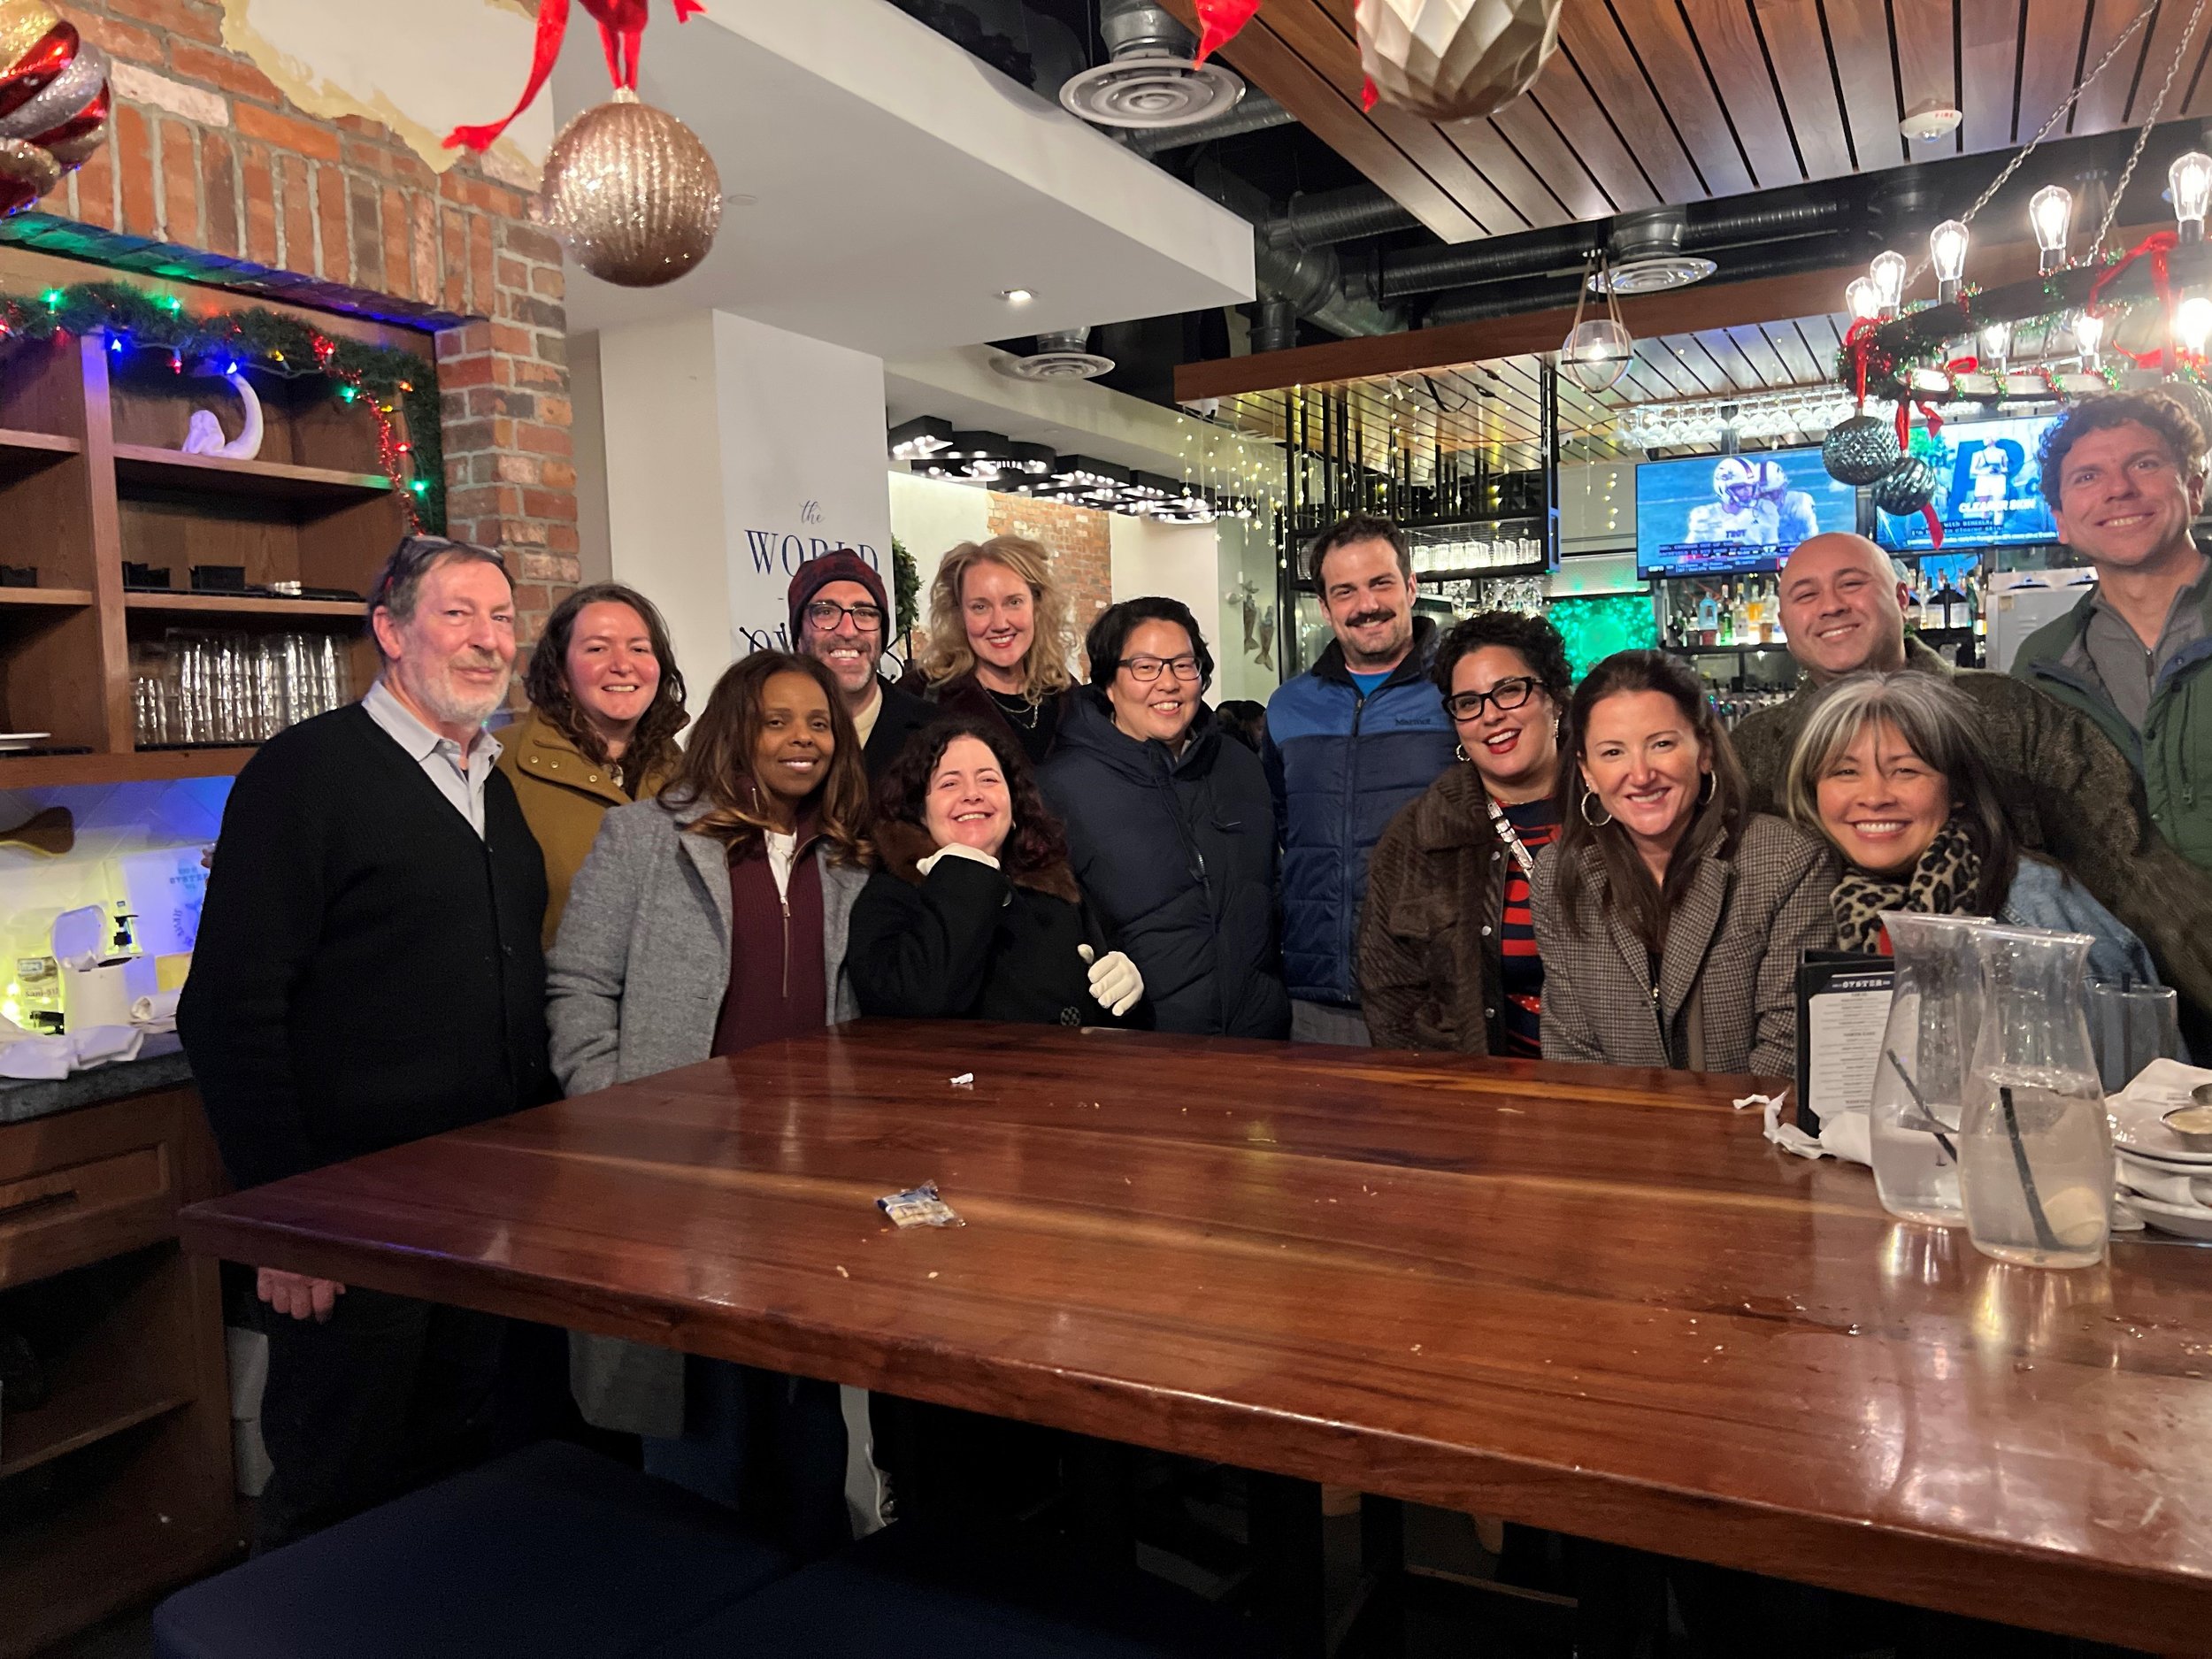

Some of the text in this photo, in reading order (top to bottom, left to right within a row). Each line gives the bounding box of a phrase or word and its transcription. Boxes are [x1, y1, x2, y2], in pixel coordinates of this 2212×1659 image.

[799, 500, 826, 525] the
[744, 530, 879, 577] WOD
[1395, 718, 1432, 726] Marmot
[1842, 979, 1883, 989] OYSTER
